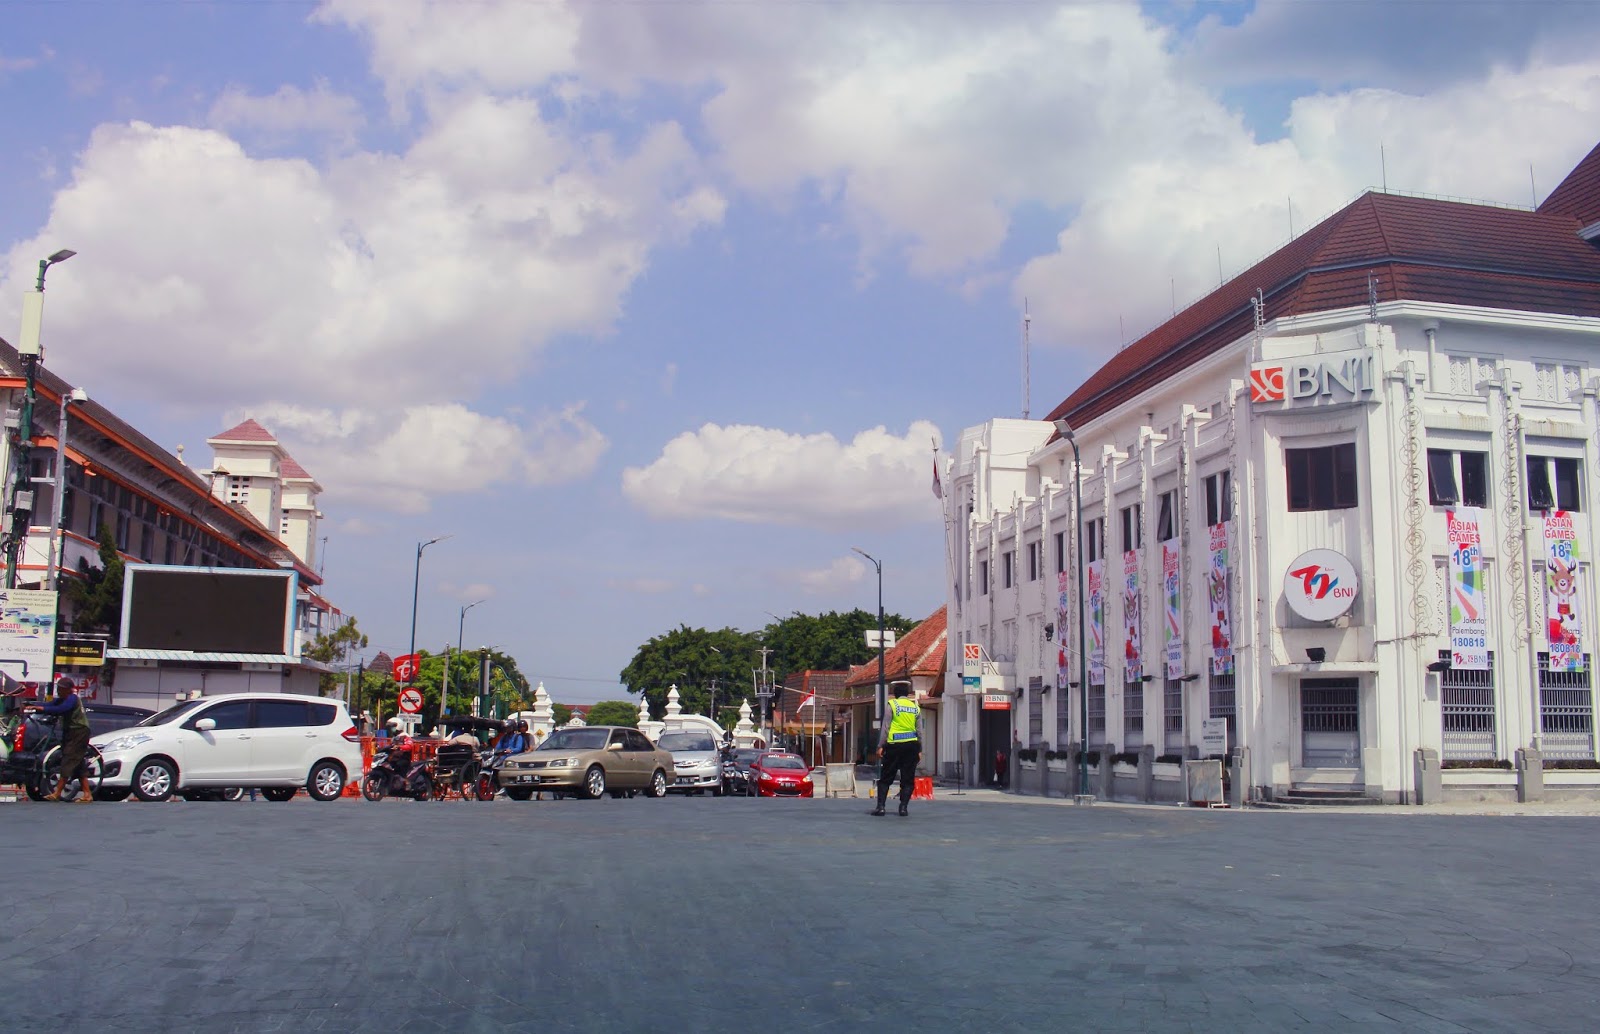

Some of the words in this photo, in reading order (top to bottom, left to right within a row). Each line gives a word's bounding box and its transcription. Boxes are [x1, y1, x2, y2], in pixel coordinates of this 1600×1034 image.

[1292, 357, 1374, 399] BNI
[1450, 521, 1478, 531] ASIAN
[1545, 518, 1573, 528] ASIAN
[1211, 529, 1226, 540] ASIAN
[1449, 533, 1481, 543] GAMES
[1544, 529, 1575, 539] GAMES
[1210, 540, 1226, 551] GAMES
[1551, 541, 1572, 557] 18th
[1453, 547, 1478, 566] 18th
[1333, 588, 1354, 598] BNI
[1452, 626, 1485, 636] Palembang
[1453, 638, 1485, 647] 180818
[1550, 644, 1581, 653] 180818
